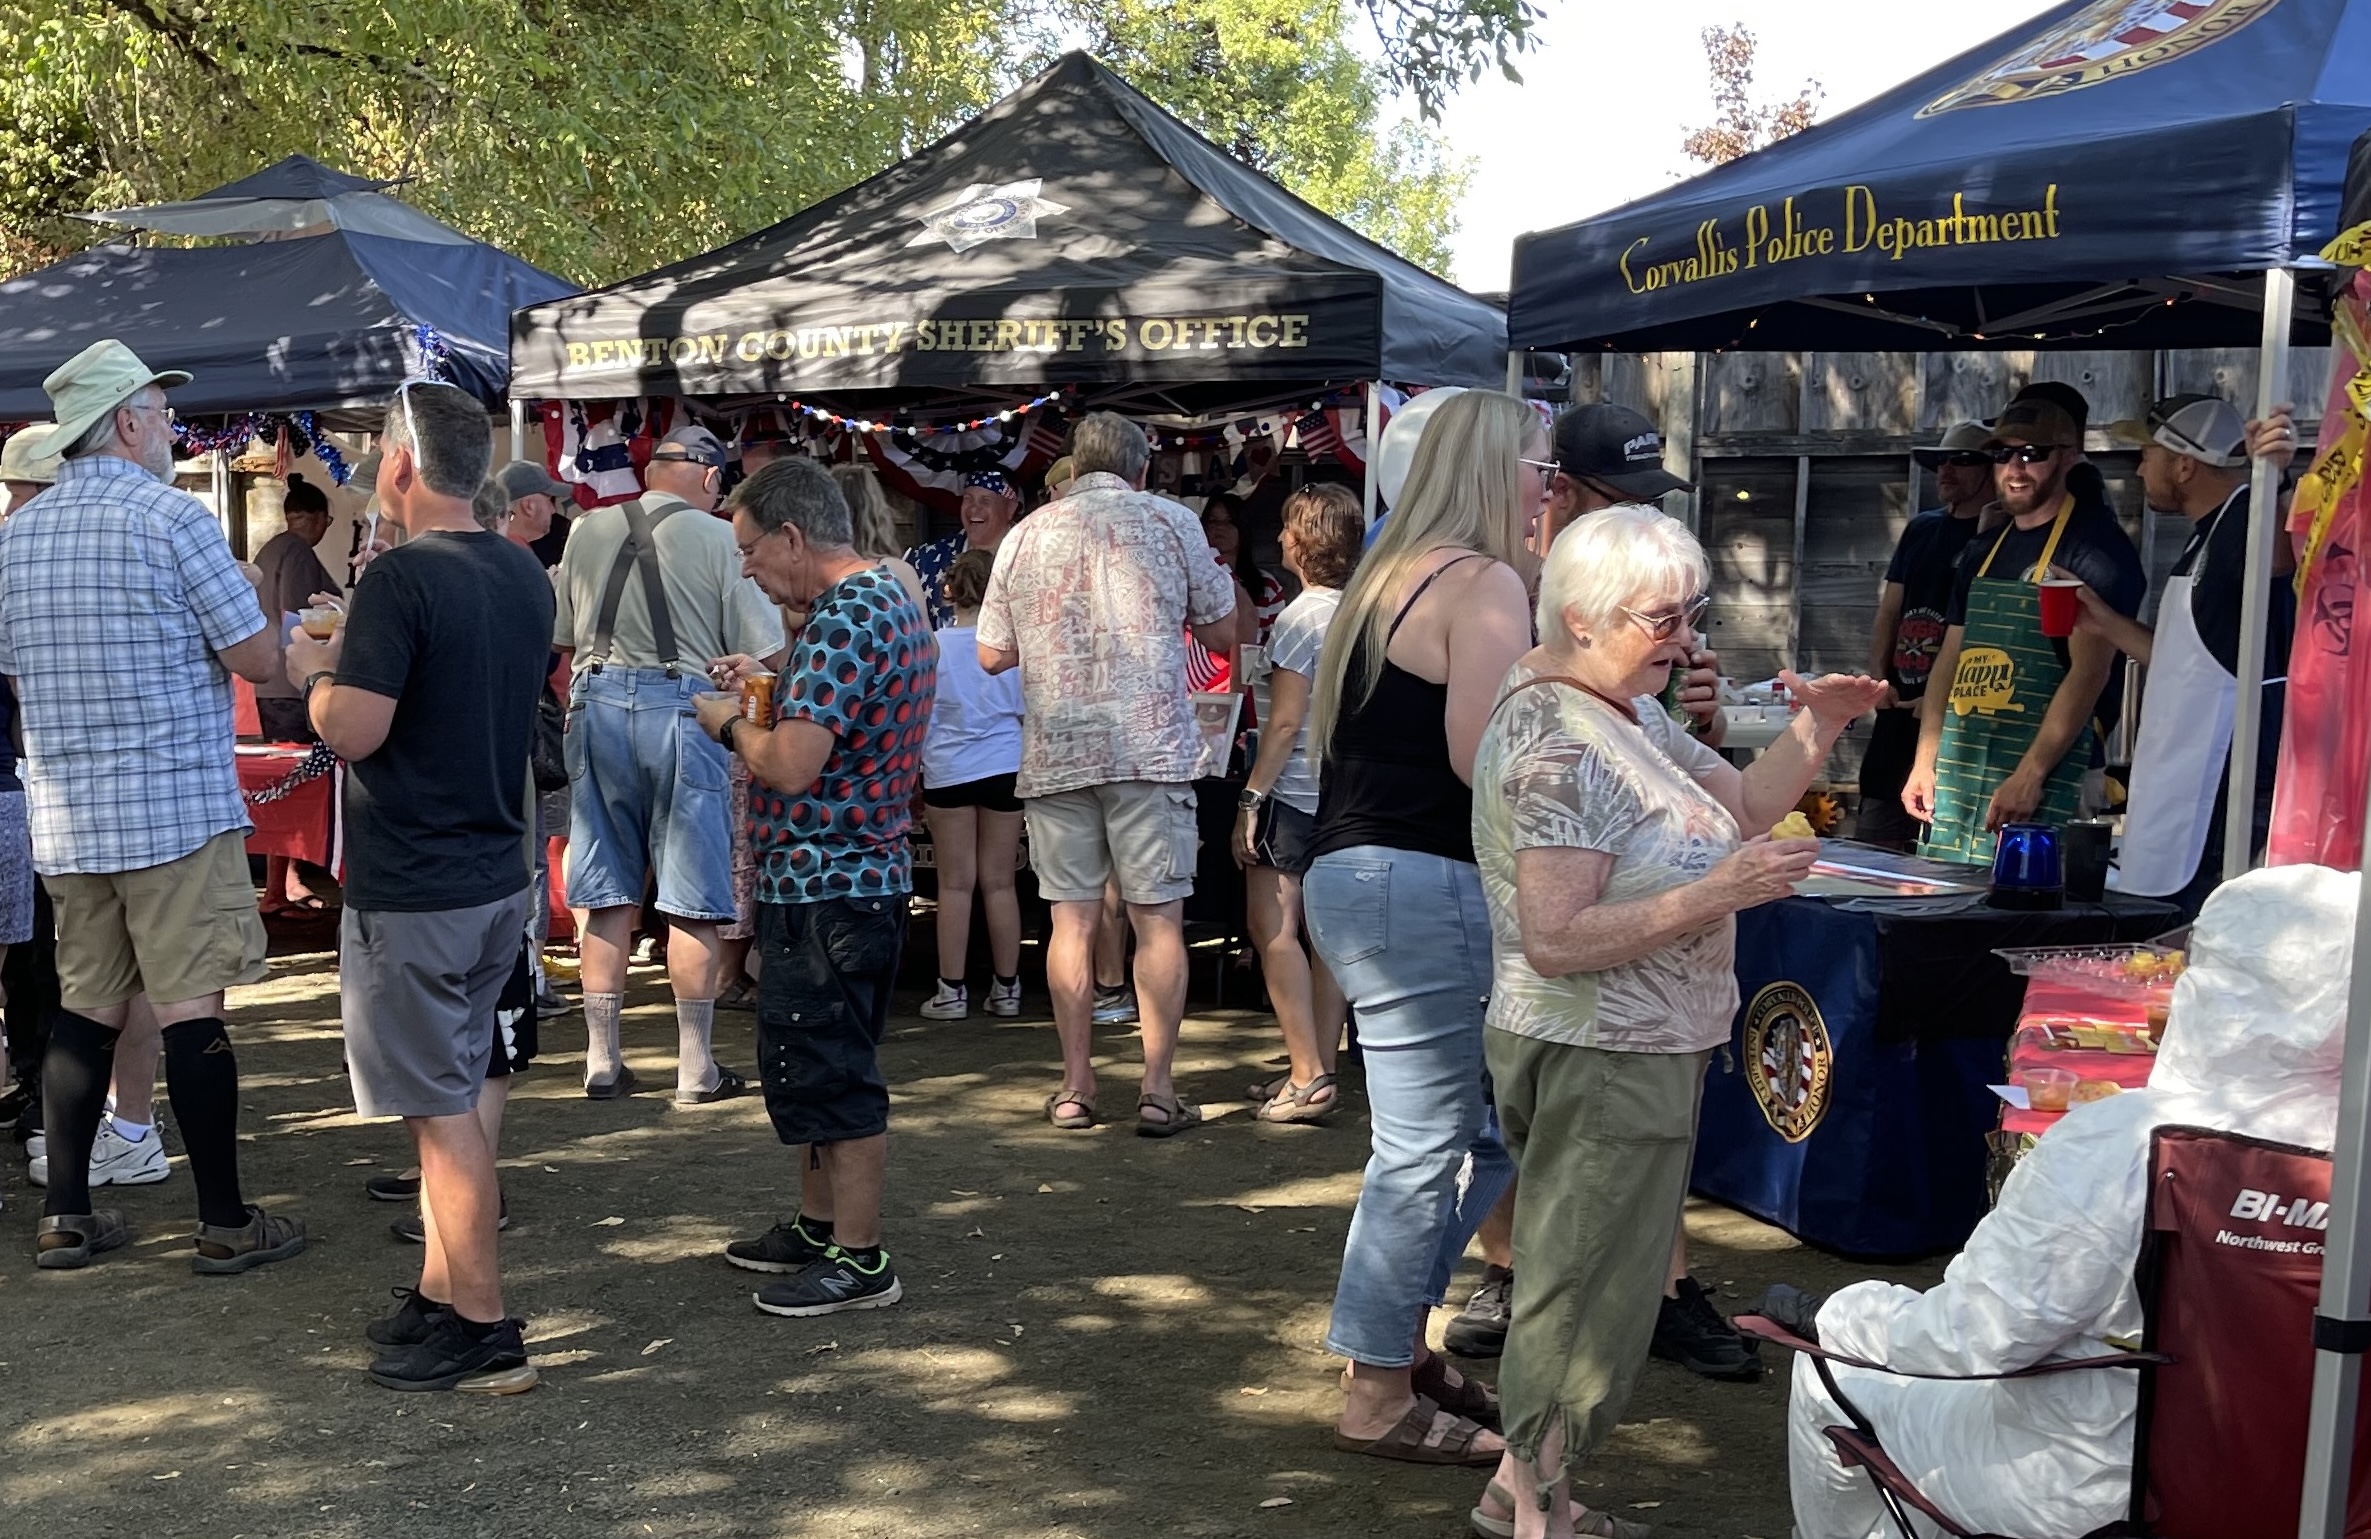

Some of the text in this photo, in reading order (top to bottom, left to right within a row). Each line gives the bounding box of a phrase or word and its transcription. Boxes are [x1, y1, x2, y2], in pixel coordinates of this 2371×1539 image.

[2102, 4, 2251, 75] HONOR
[1619, 184, 2060, 294] Corvallis Police Department
[566, 315, 1309, 372] BENTON COUNTY SHERIFF'S OFFICE
[1954, 685, 1988, 699] PLACE
[1806, 1057, 1828, 1121] HONOR
[2215, 1229, 2301, 1253] Northwest
